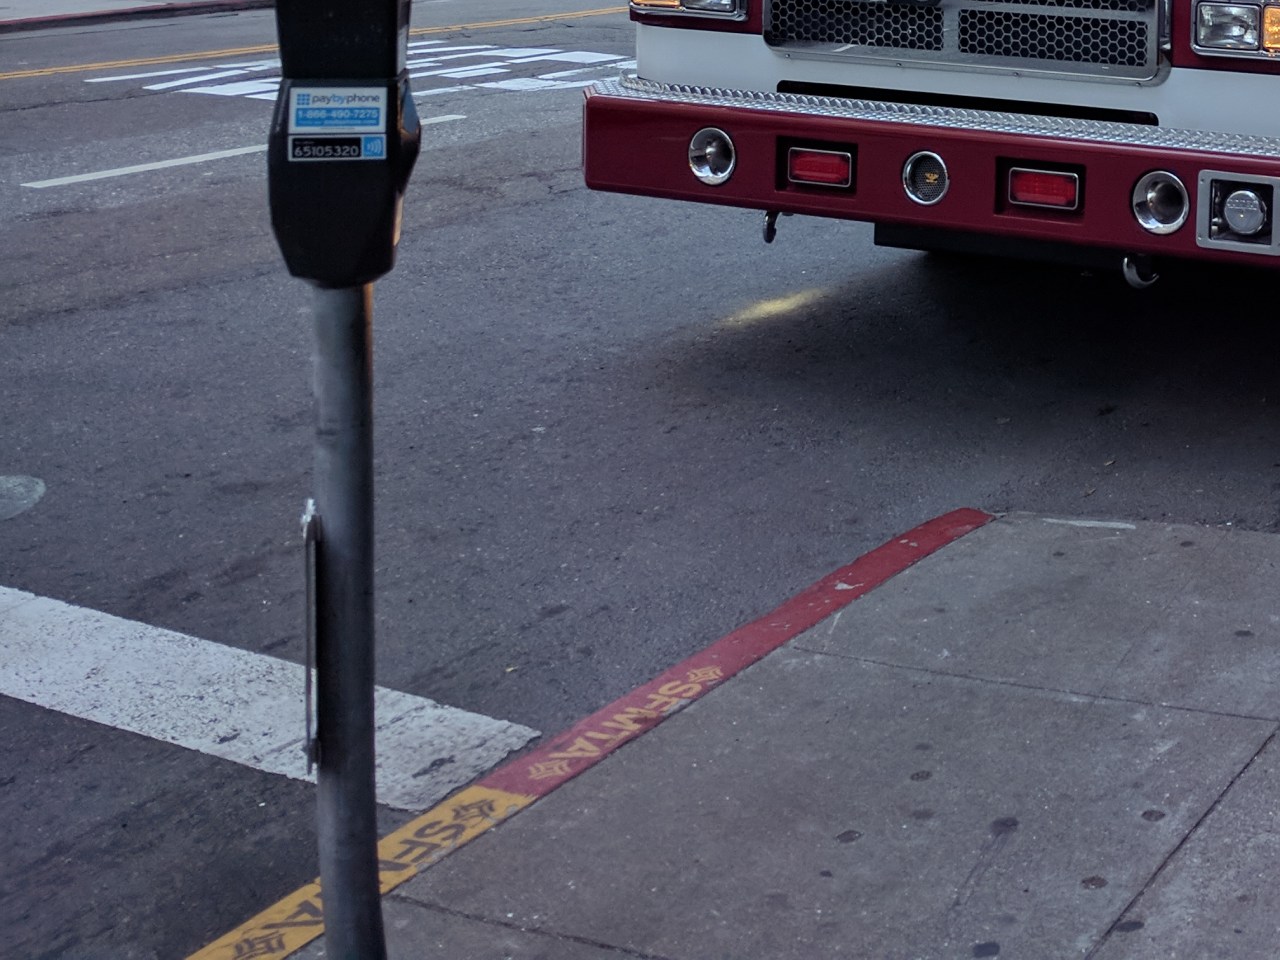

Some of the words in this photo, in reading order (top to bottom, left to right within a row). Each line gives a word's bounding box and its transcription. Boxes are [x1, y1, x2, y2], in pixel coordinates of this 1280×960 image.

[312, 93, 380, 105] paybyphone
[294, 146, 359, 157] 65105320
[560, 679, 703, 762] SFMTA
